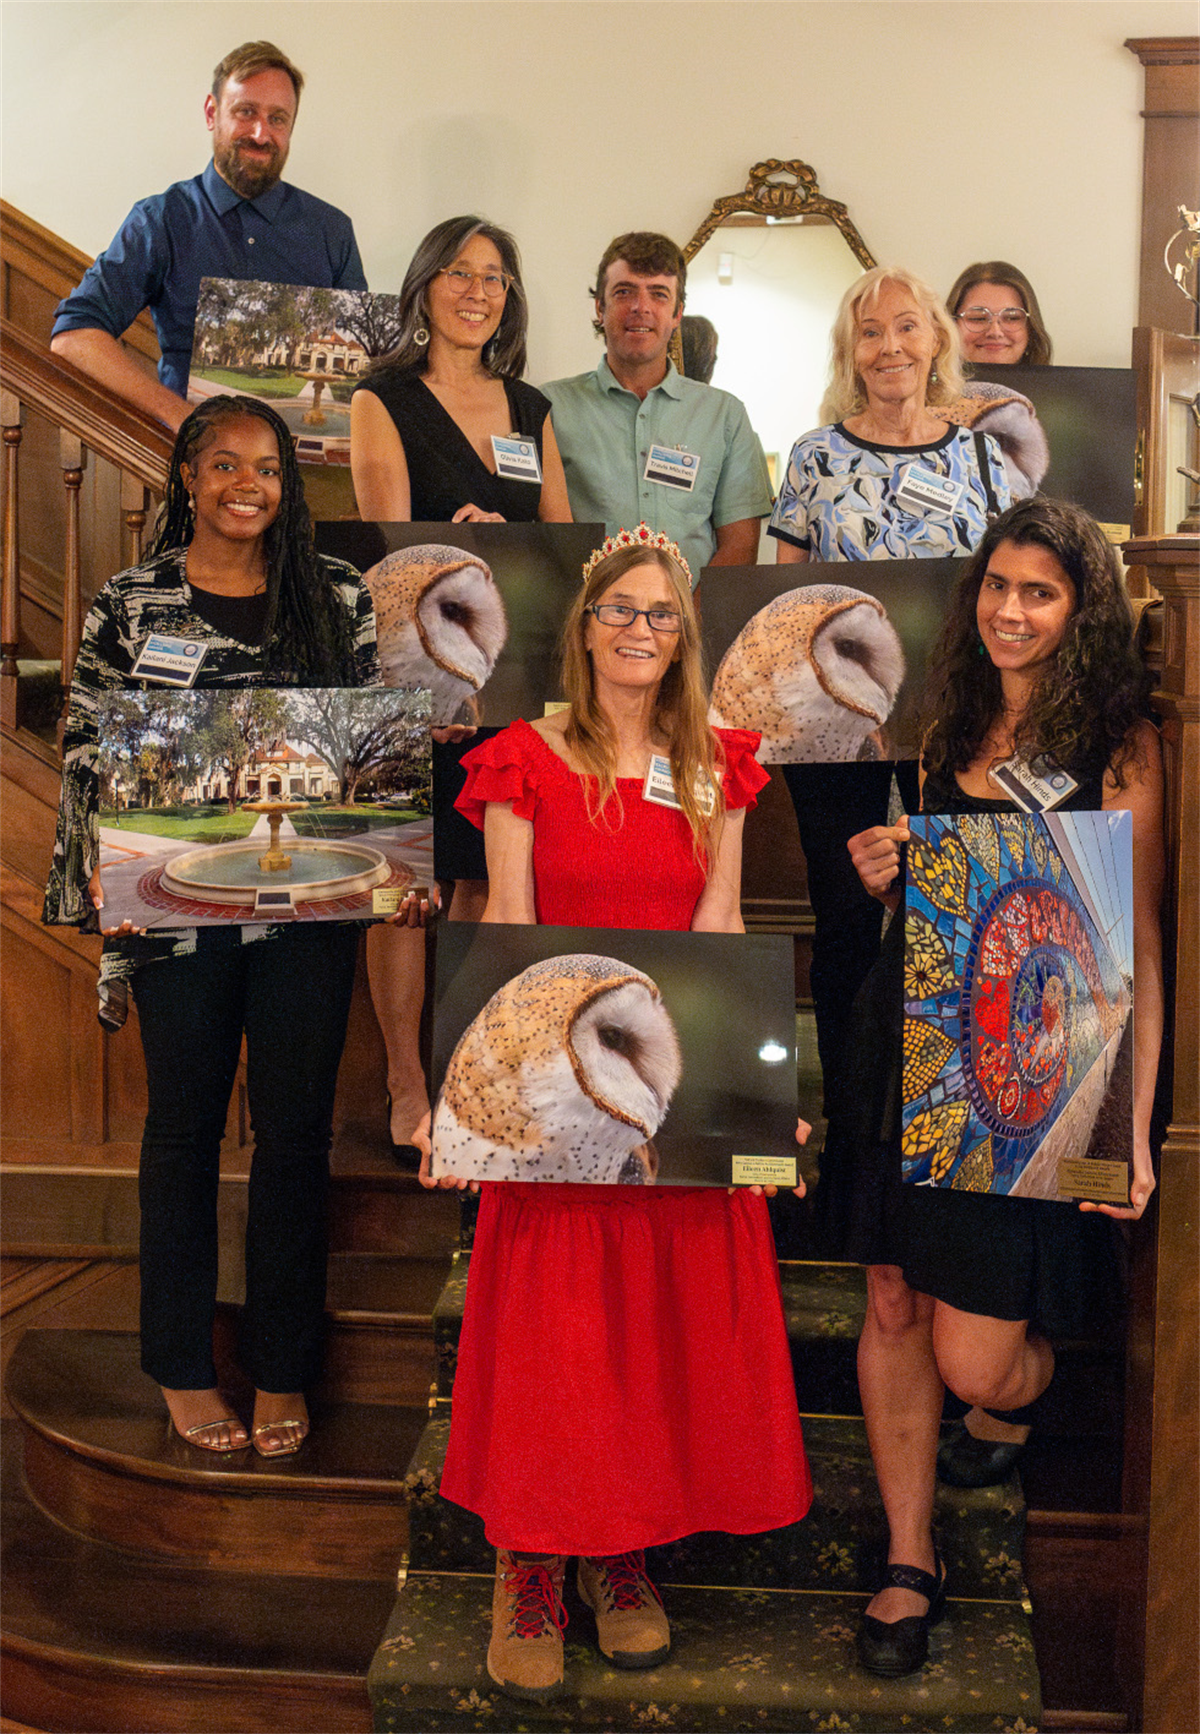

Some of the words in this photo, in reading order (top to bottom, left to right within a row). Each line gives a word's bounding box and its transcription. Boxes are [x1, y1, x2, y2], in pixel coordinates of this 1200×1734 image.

[650, 460, 668, 470] Travis
[669, 465, 694, 477] Mitchell
[907, 479, 925, 490] Faye
[926, 487, 954, 503] Medley
[167, 657, 197, 669] Jackson
[1011, 761, 1032, 783] Sarah
[1030, 780, 1052, 802] Hinds
